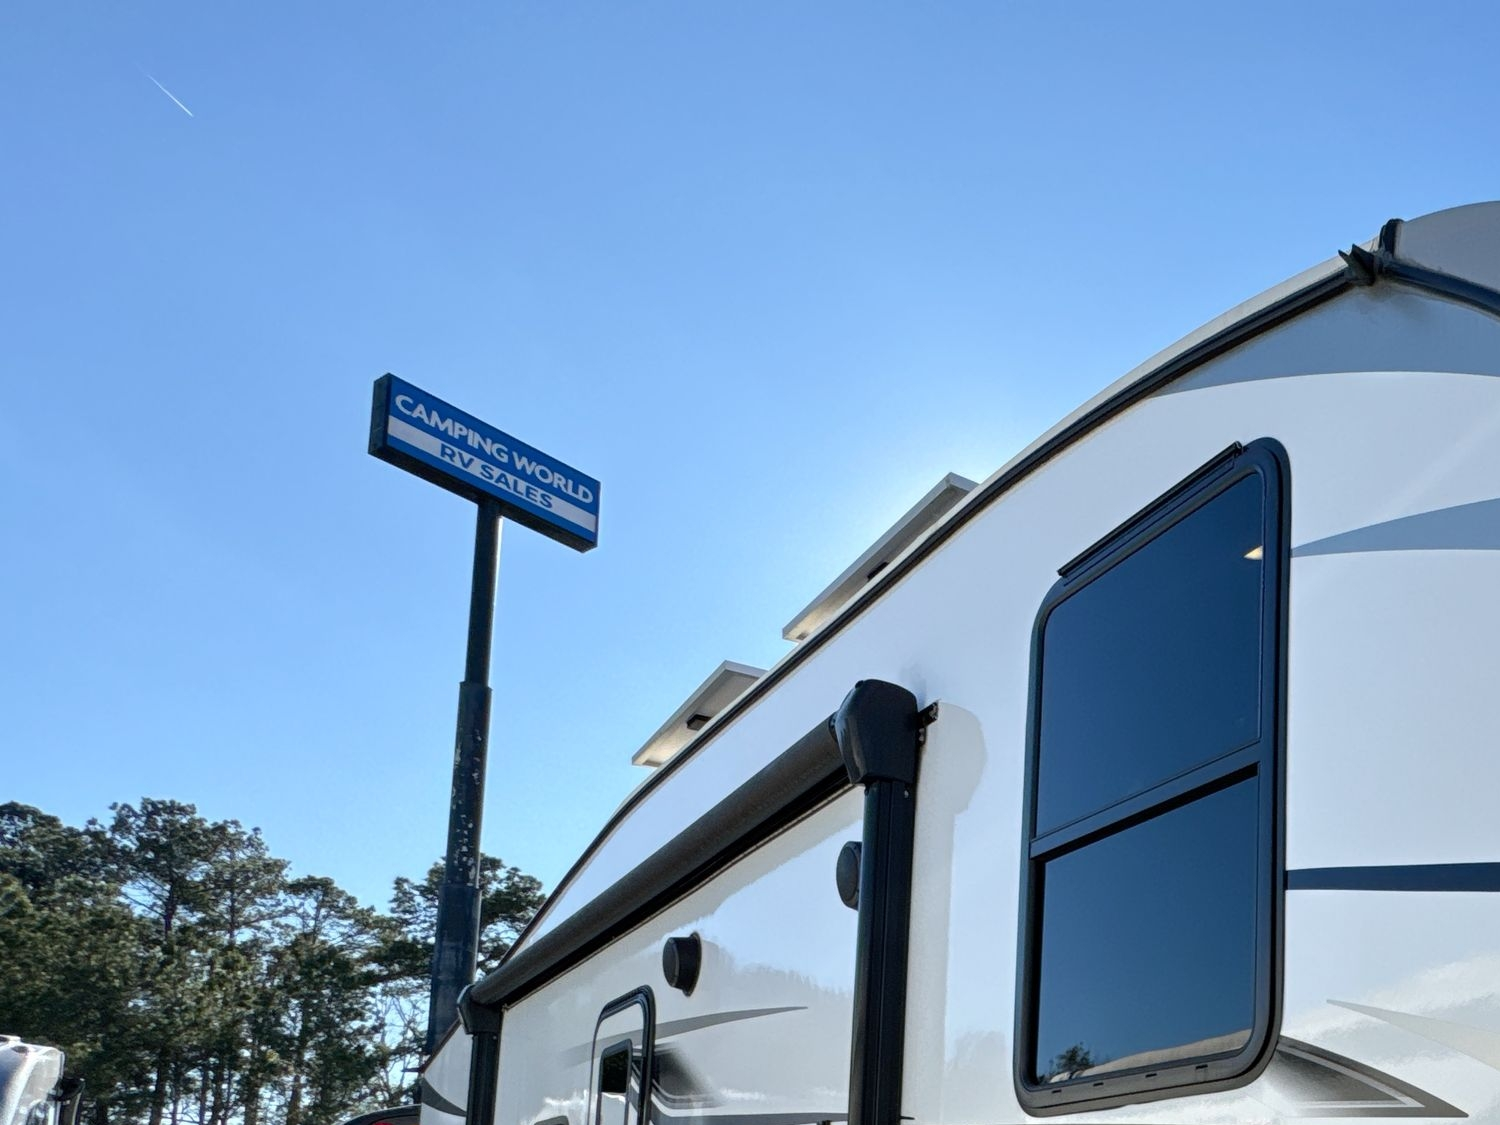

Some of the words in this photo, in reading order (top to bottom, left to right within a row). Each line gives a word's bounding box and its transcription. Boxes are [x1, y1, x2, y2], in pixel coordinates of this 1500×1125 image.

[395, 394, 509, 464] CAMPING
[512, 451, 593, 505] WORLD
[440, 443, 475, 470] RV
[480, 464, 553, 509] SALES
